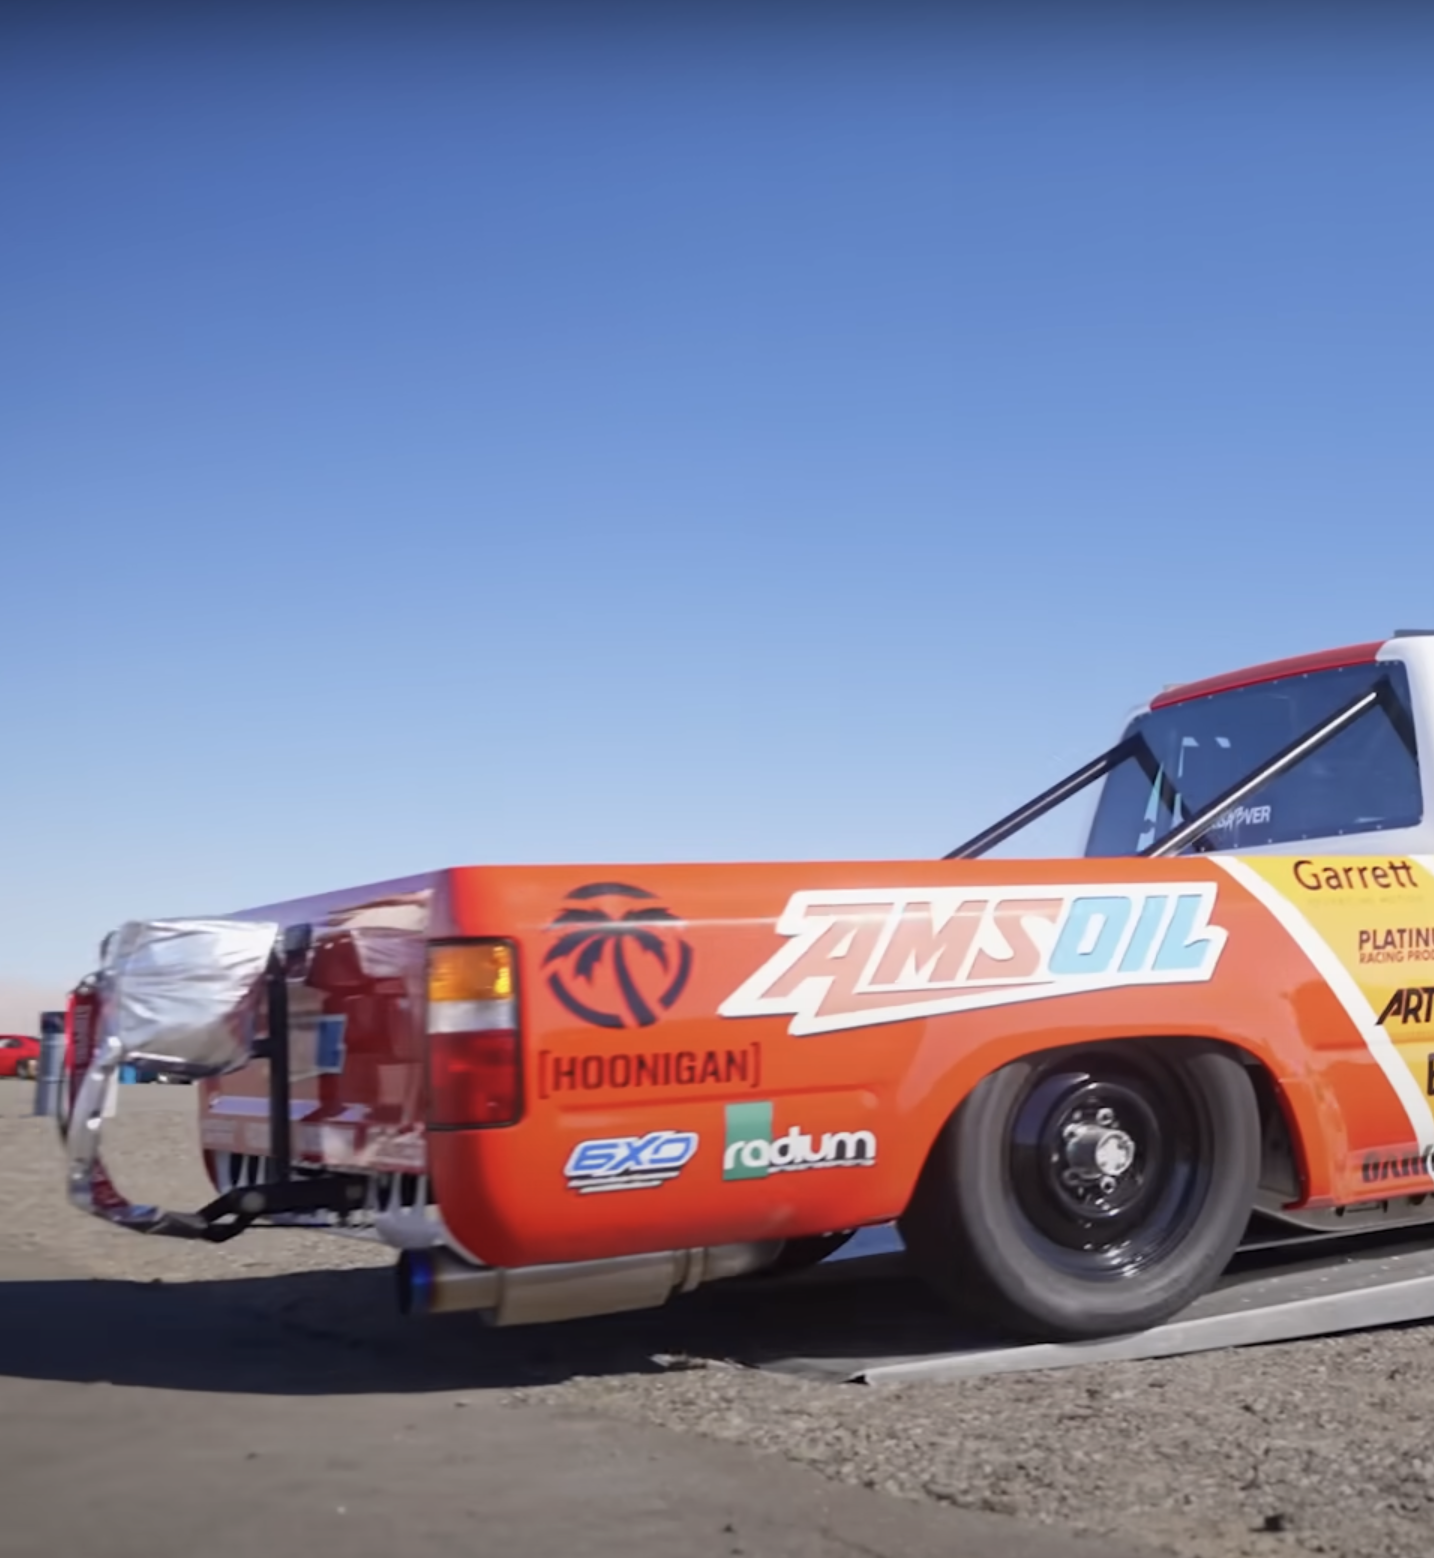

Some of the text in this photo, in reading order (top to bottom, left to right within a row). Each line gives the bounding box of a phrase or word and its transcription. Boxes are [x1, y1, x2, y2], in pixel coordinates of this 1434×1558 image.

[1293, 859, 1418, 891] Garrett
[740, 887, 1220, 1027] AMSOIL
[1359, 951, 1404, 965] RACING
[538, 1042, 762, 1100] [HOONIGAN]
